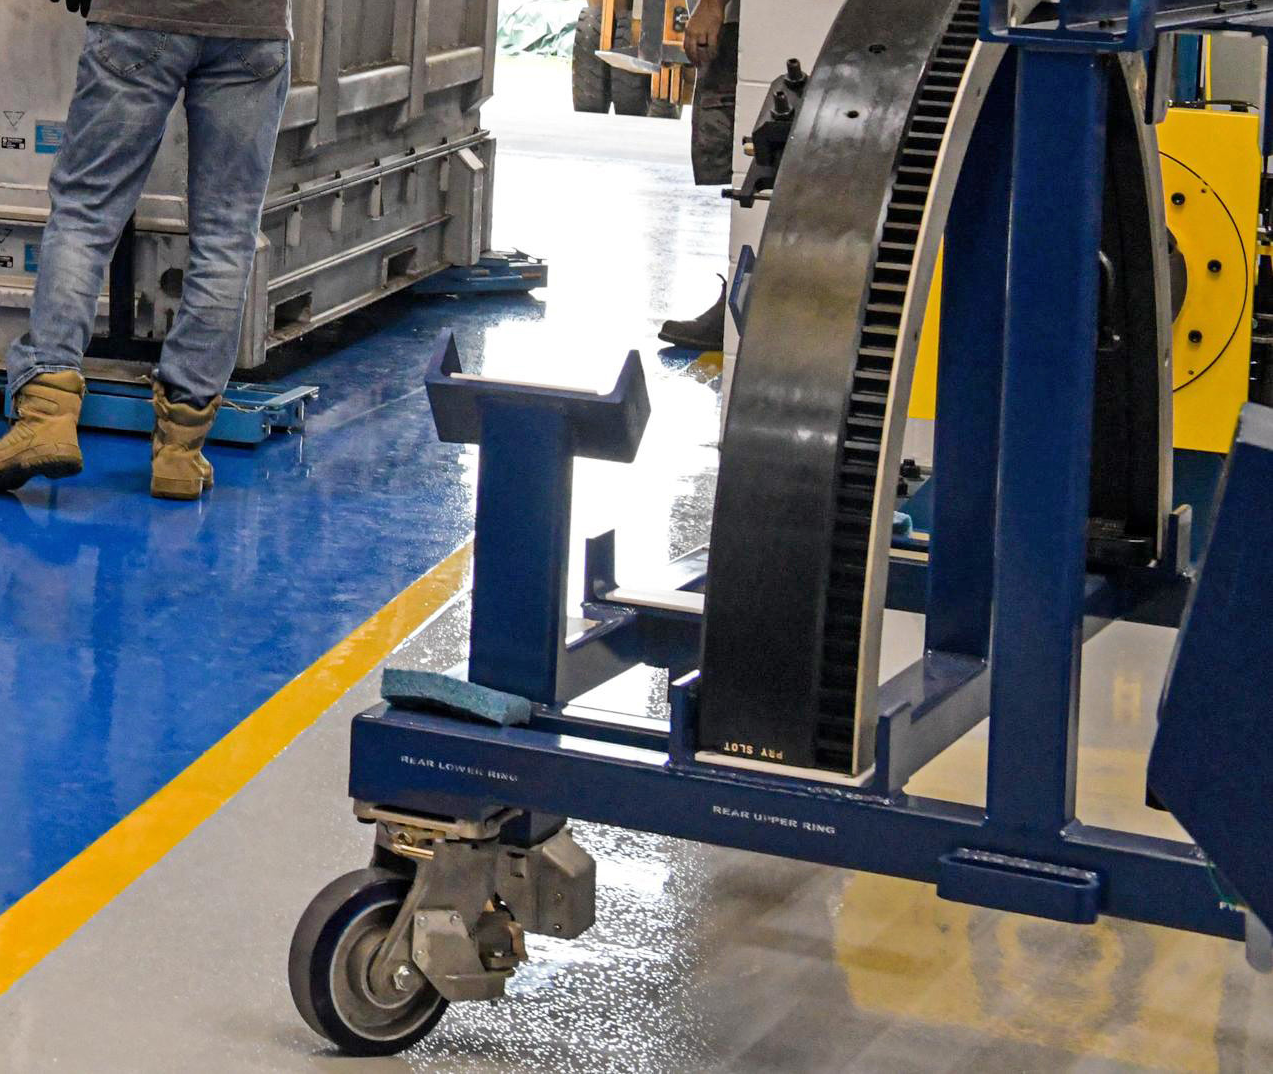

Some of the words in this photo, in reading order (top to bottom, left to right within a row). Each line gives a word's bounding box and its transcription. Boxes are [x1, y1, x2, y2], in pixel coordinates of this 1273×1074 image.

[400, 755, 435, 768] REAR
[438, 761, 484, 776] LOWER
[487, 769, 518, 782] RING
[712, 805, 750, 819] REAR
[753, 813, 798, 828] UPPER
[802, 821, 836, 834] RING
